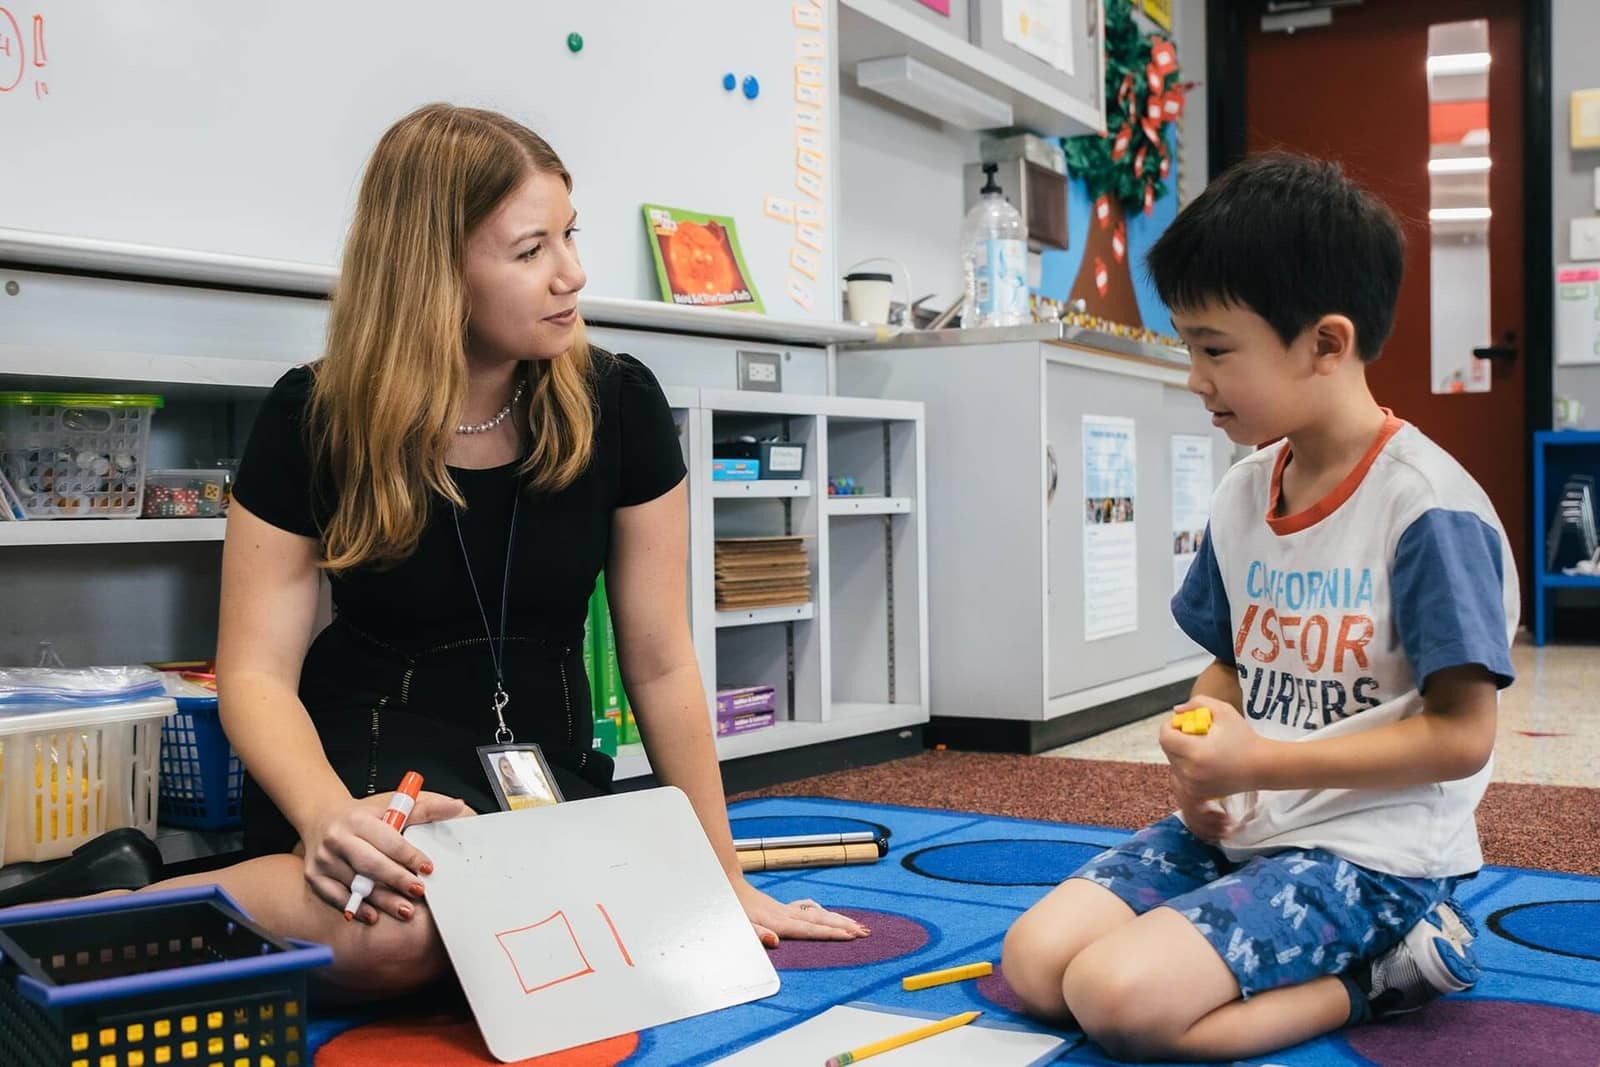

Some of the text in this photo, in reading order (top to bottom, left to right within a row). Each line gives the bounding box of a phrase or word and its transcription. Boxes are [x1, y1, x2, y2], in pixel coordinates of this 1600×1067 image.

[1247, 560, 1374, 610] CIFORNIA
[1235, 604, 1375, 674] IS FOR
